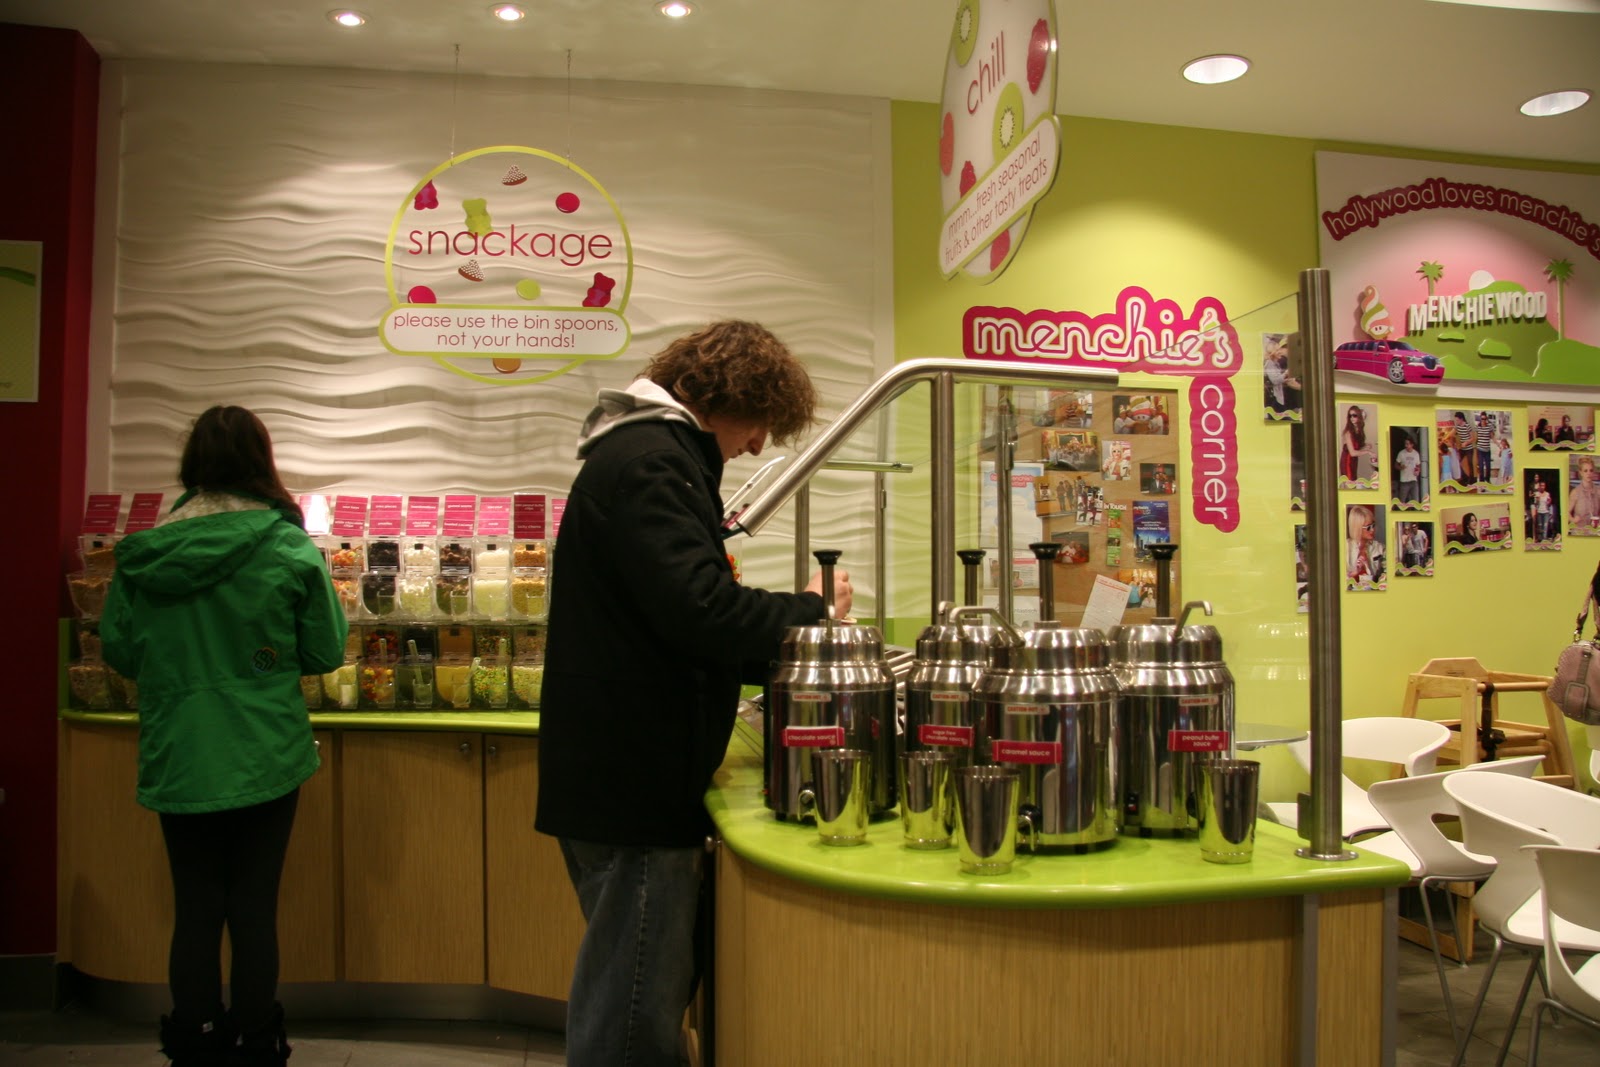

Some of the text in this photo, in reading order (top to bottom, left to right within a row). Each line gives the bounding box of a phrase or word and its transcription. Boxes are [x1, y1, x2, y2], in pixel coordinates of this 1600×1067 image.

[967, 30, 1006, 115] chill
[998, 131, 1041, 191] seasonal
[945, 157, 1048, 265] fruits & other tasty treats
[1327, 183, 1600, 252] hollywood loves menchie's
[408, 224, 613, 266] snackage
[394, 312, 619, 334] please use the bin spoons,
[437, 333, 576, 349] not your hands!
[973, 296, 1234, 368] menchie's
[1409, 291, 1548, 332] MENCHIEWOOD
[1200, 384, 1228, 520] corner
